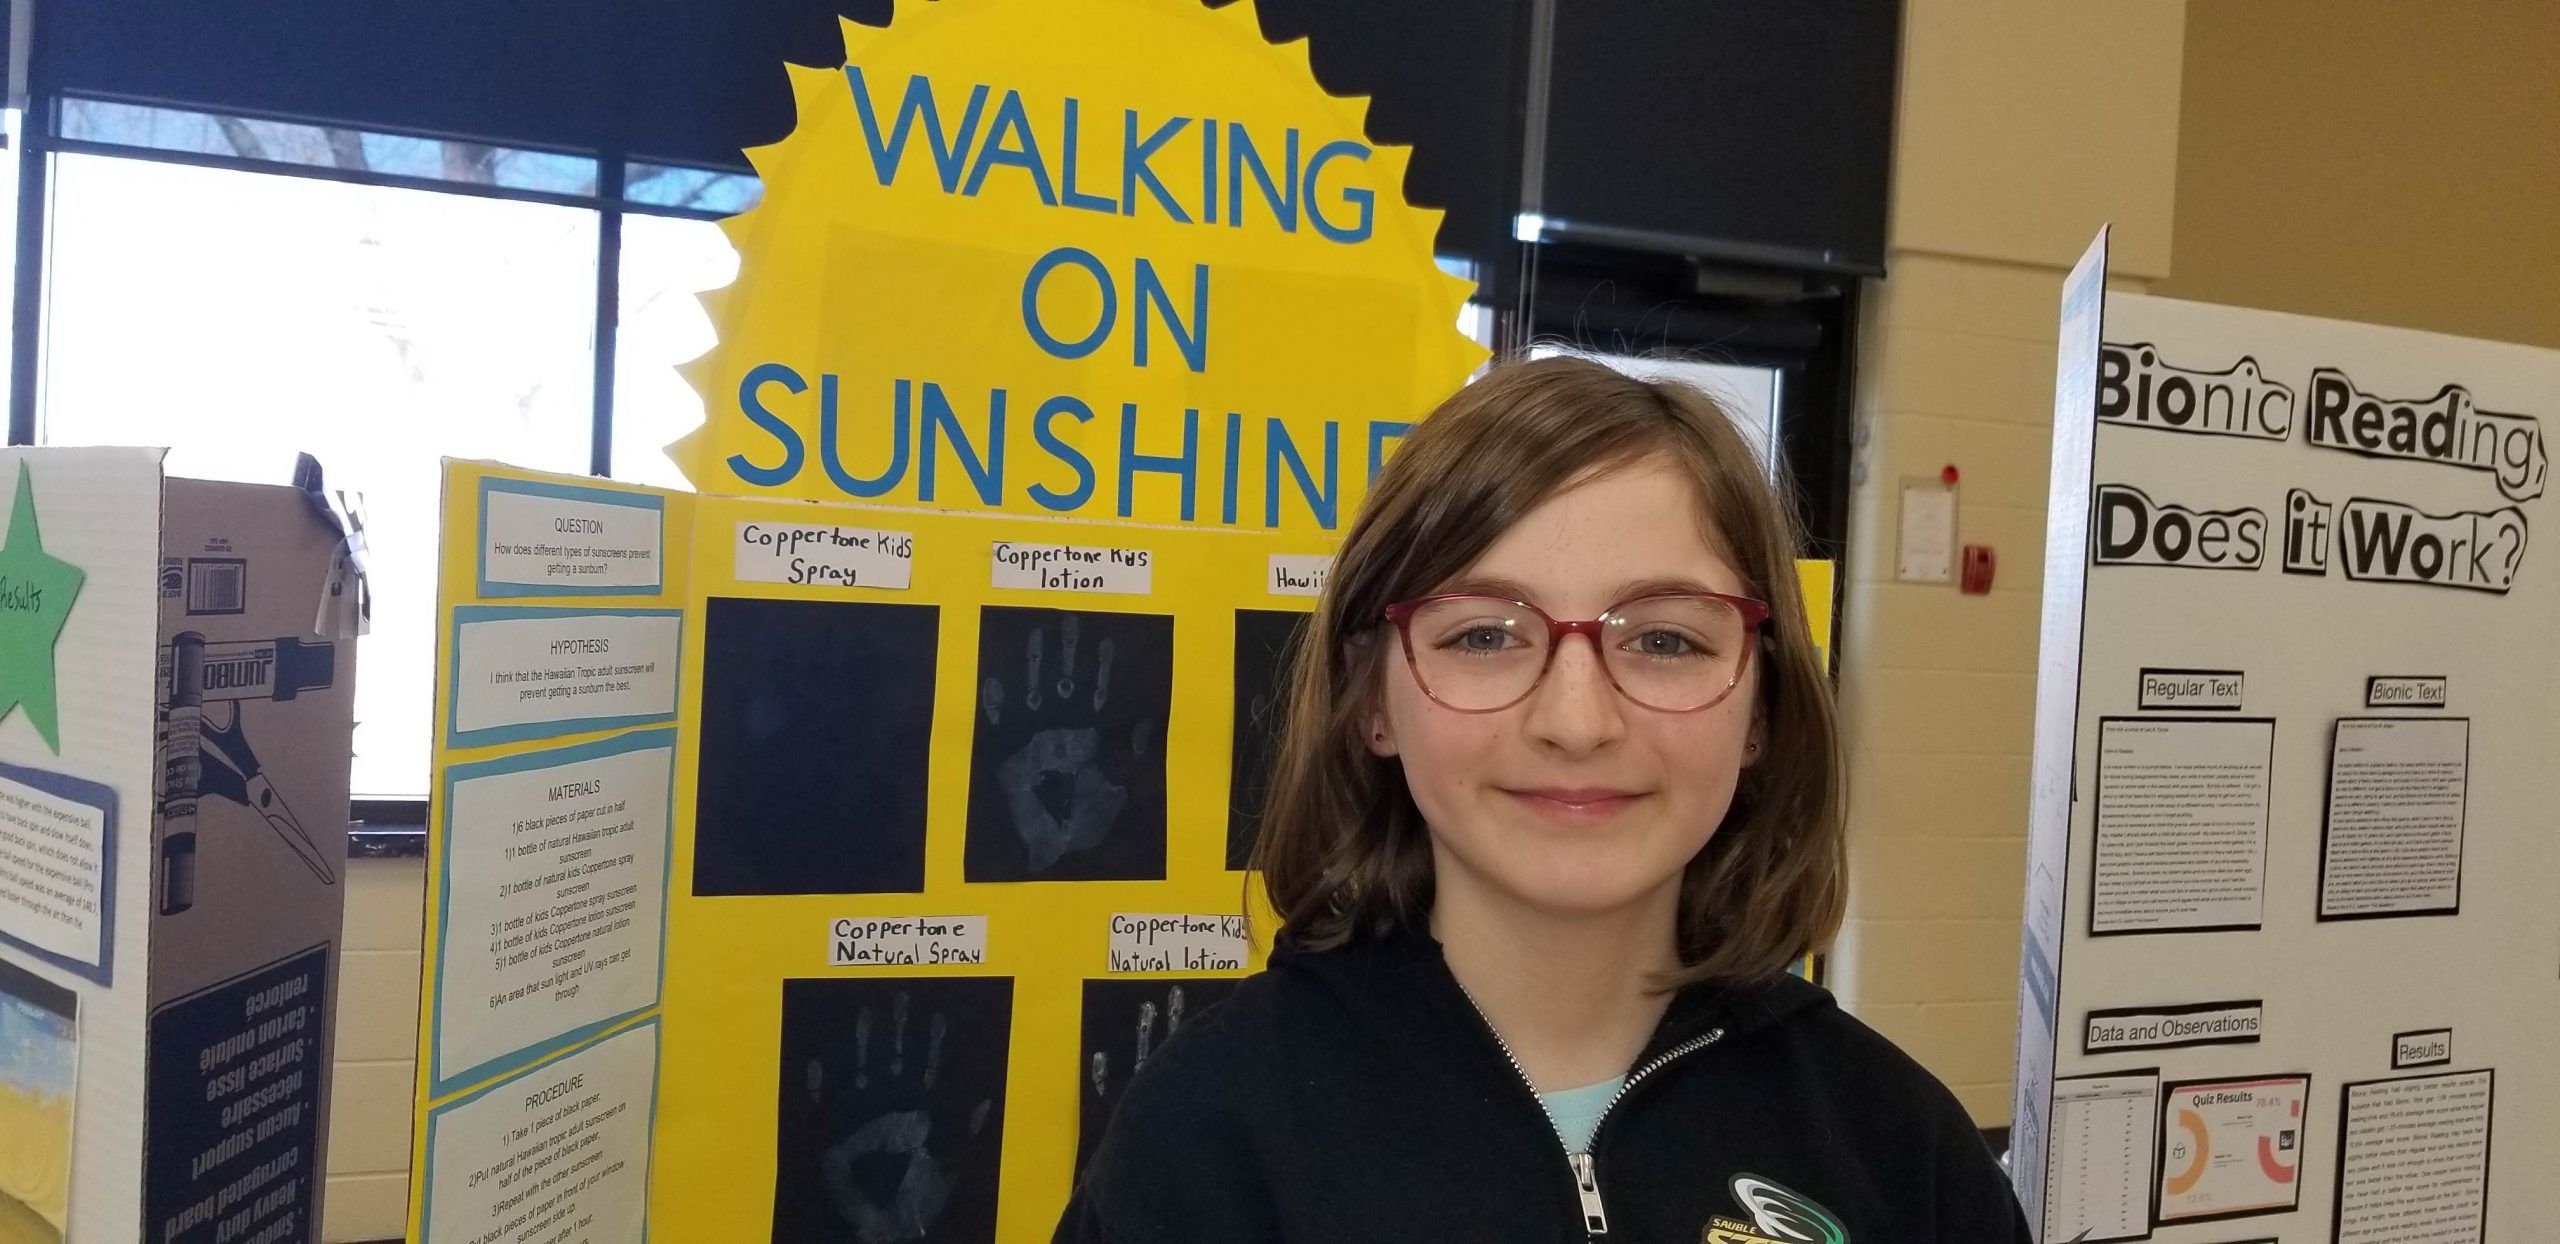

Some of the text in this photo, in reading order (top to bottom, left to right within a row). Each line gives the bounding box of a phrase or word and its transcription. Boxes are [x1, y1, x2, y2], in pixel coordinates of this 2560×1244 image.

[845, 64, 1375, 244] WALKING
[1022, 247, 1209, 373] ON
[2100, 349, 2544, 488] Bionic Reading,
[555, 518, 602, 534] QUESTION
[2101, 491, 2521, 585] Does it Work?
[495, 542, 650, 560] How does different types of sunscreens prevent
[744, 525, 912, 558] Coppertone Kids
[548, 564, 607, 576] getting a sunburn?
[996, 544, 1101, 570] Coppertone
[788, 558, 856, 586] Spray
[1041, 568, 1103, 589] lotion
[1276, 567, 1324, 587] Hawii
[551, 639, 609, 655] HYPOTHESIS
[203, 660, 272, 690] JUMBO
[496, 671, 513, 683] think
[516, 670, 529, 682] that
[531, 670, 542, 681] the
[544, 668, 575, 680] Hawaiian
[577, 666, 596, 679] Tropic
[598, 665, 612, 676] adult
[614, 664, 644, 675] sunscreen
[646, 662, 654, 672] will
[520, 687, 546, 702] prevent
[549, 686, 571, 699] getting
[573, 686, 577, 695] a
[579, 683, 603, 695] sunburn
[605, 682, 614, 692] the
[2146, 678, 2239, 700] Regular Text
[2374, 683, 2443, 700] Bionic Text
[549, 780, 600, 802] MATERIALS
[512, 800, 625, 835] 1)6 black pieces of paper cut in half
[505, 821, 634, 862] 1)1 bottle of natural Hawaiian tropic adult
[491, 884, 637, 936] 3)1 bottle of kids Coppertone spray sunscreen
[490, 942, 501, 955] 4)1
[504, 936, 523, 949] bottle
[525, 931, 533, 942] of
[534, 926, 548, 939] kids
[550, 916, 586, 936] Coppertone
[835, 919, 964, 939] Coppertone
[1112, 915, 1215, 945] Coppertone
[552, 948, 585, 968] sunscreen
[837, 941, 980, 964] Natural Spray
[1112, 947, 1238, 971] Natural lotion
[200, 1007, 305, 1075] Carton ondulé
[2090, 1015, 2258, 1044] Data and Observations
[2400, 1041, 2444, 1063] Results
[207, 1039, 303, 1101] Surface lisse
[525, 1073, 584, 1112] PROCEDURE
[2193, 1092, 2252, 1108] Quiz Results
[503, 1135, 509, 1147] 1)
[512, 1127, 527, 1142] Take
[536, 1115, 553, 1133] piece
[555, 1108, 562, 1121] of
[563, 1102, 579, 1117] black
[192, 1102, 300, 1181] Aucun support
[165, 1147, 298, 1244] corrugated board
[217, 1179, 296, 1244] Heavy duty
[1713, 1219, 1756, 1234] SAUBLE
